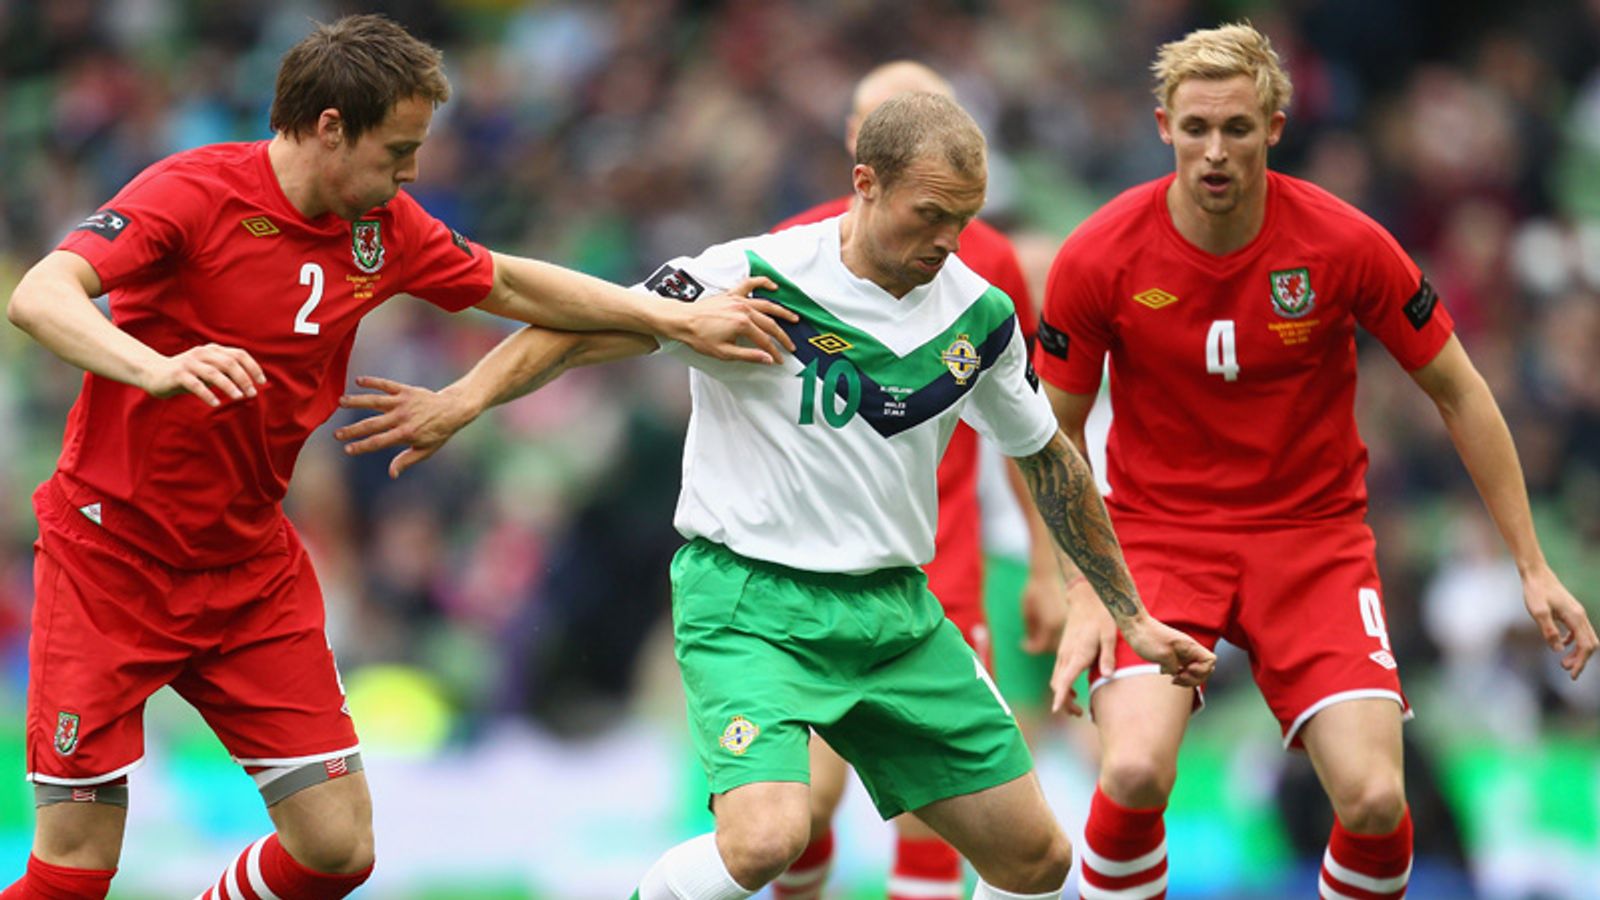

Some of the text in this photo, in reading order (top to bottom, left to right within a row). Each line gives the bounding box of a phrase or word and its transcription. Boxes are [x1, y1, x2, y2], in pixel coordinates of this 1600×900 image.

[294, 262, 324, 335] 2
[1206, 320, 1240, 381] 4
[795, 357, 862, 429] 10
[1358, 587, 1390, 651] 4
